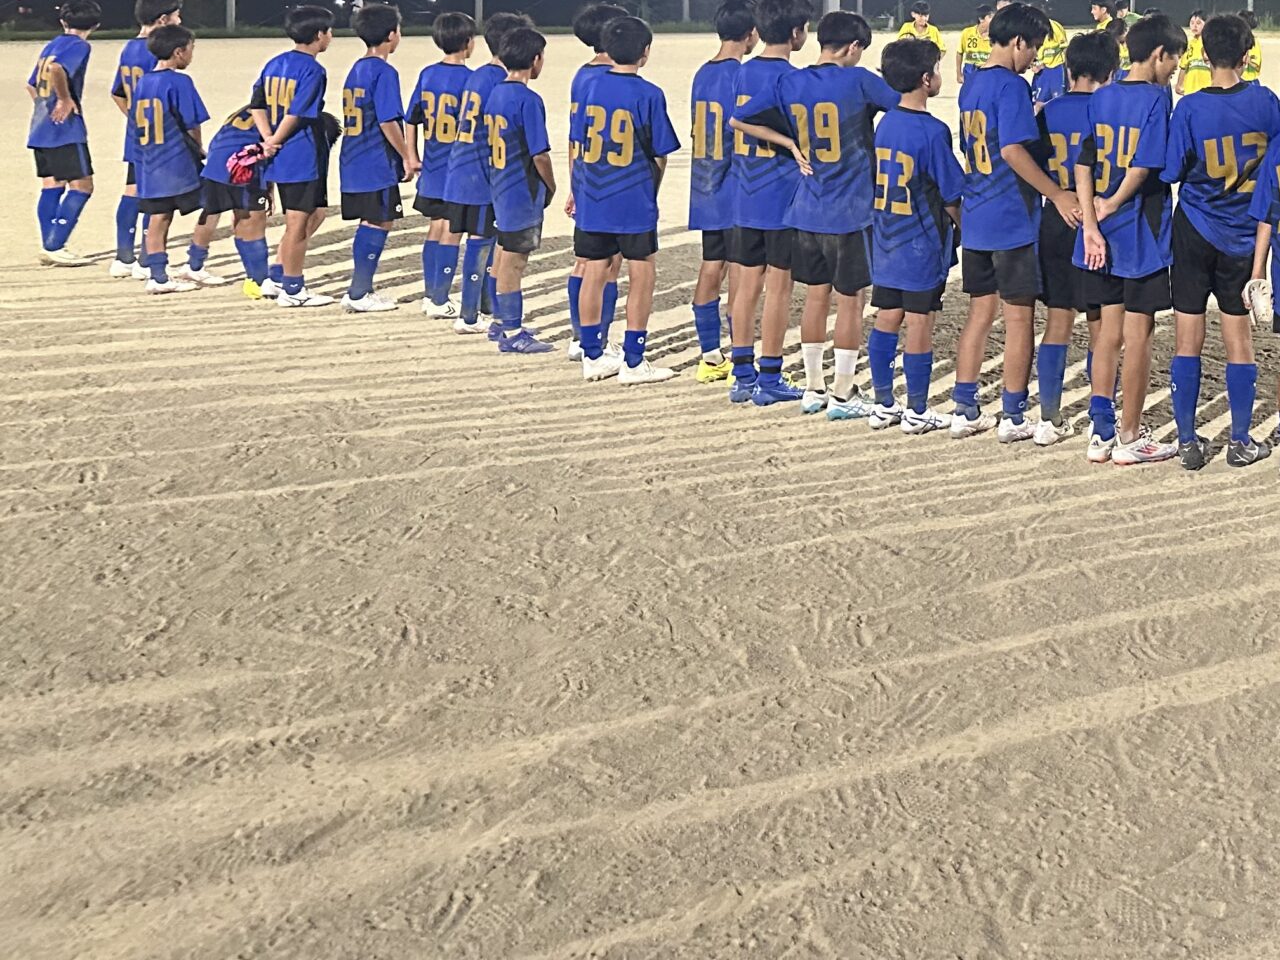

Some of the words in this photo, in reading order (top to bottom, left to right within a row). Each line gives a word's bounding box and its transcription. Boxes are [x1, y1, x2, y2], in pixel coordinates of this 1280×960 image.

[967, 37, 978, 49] 26
[136, 98, 165, 145] 51
[421, 91, 458, 143] 36
[584, 105, 635, 168] 39
[790, 101, 842, 163] 19
[874, 147, 915, 216] 53
[1204, 131, 1268, 194] 42
